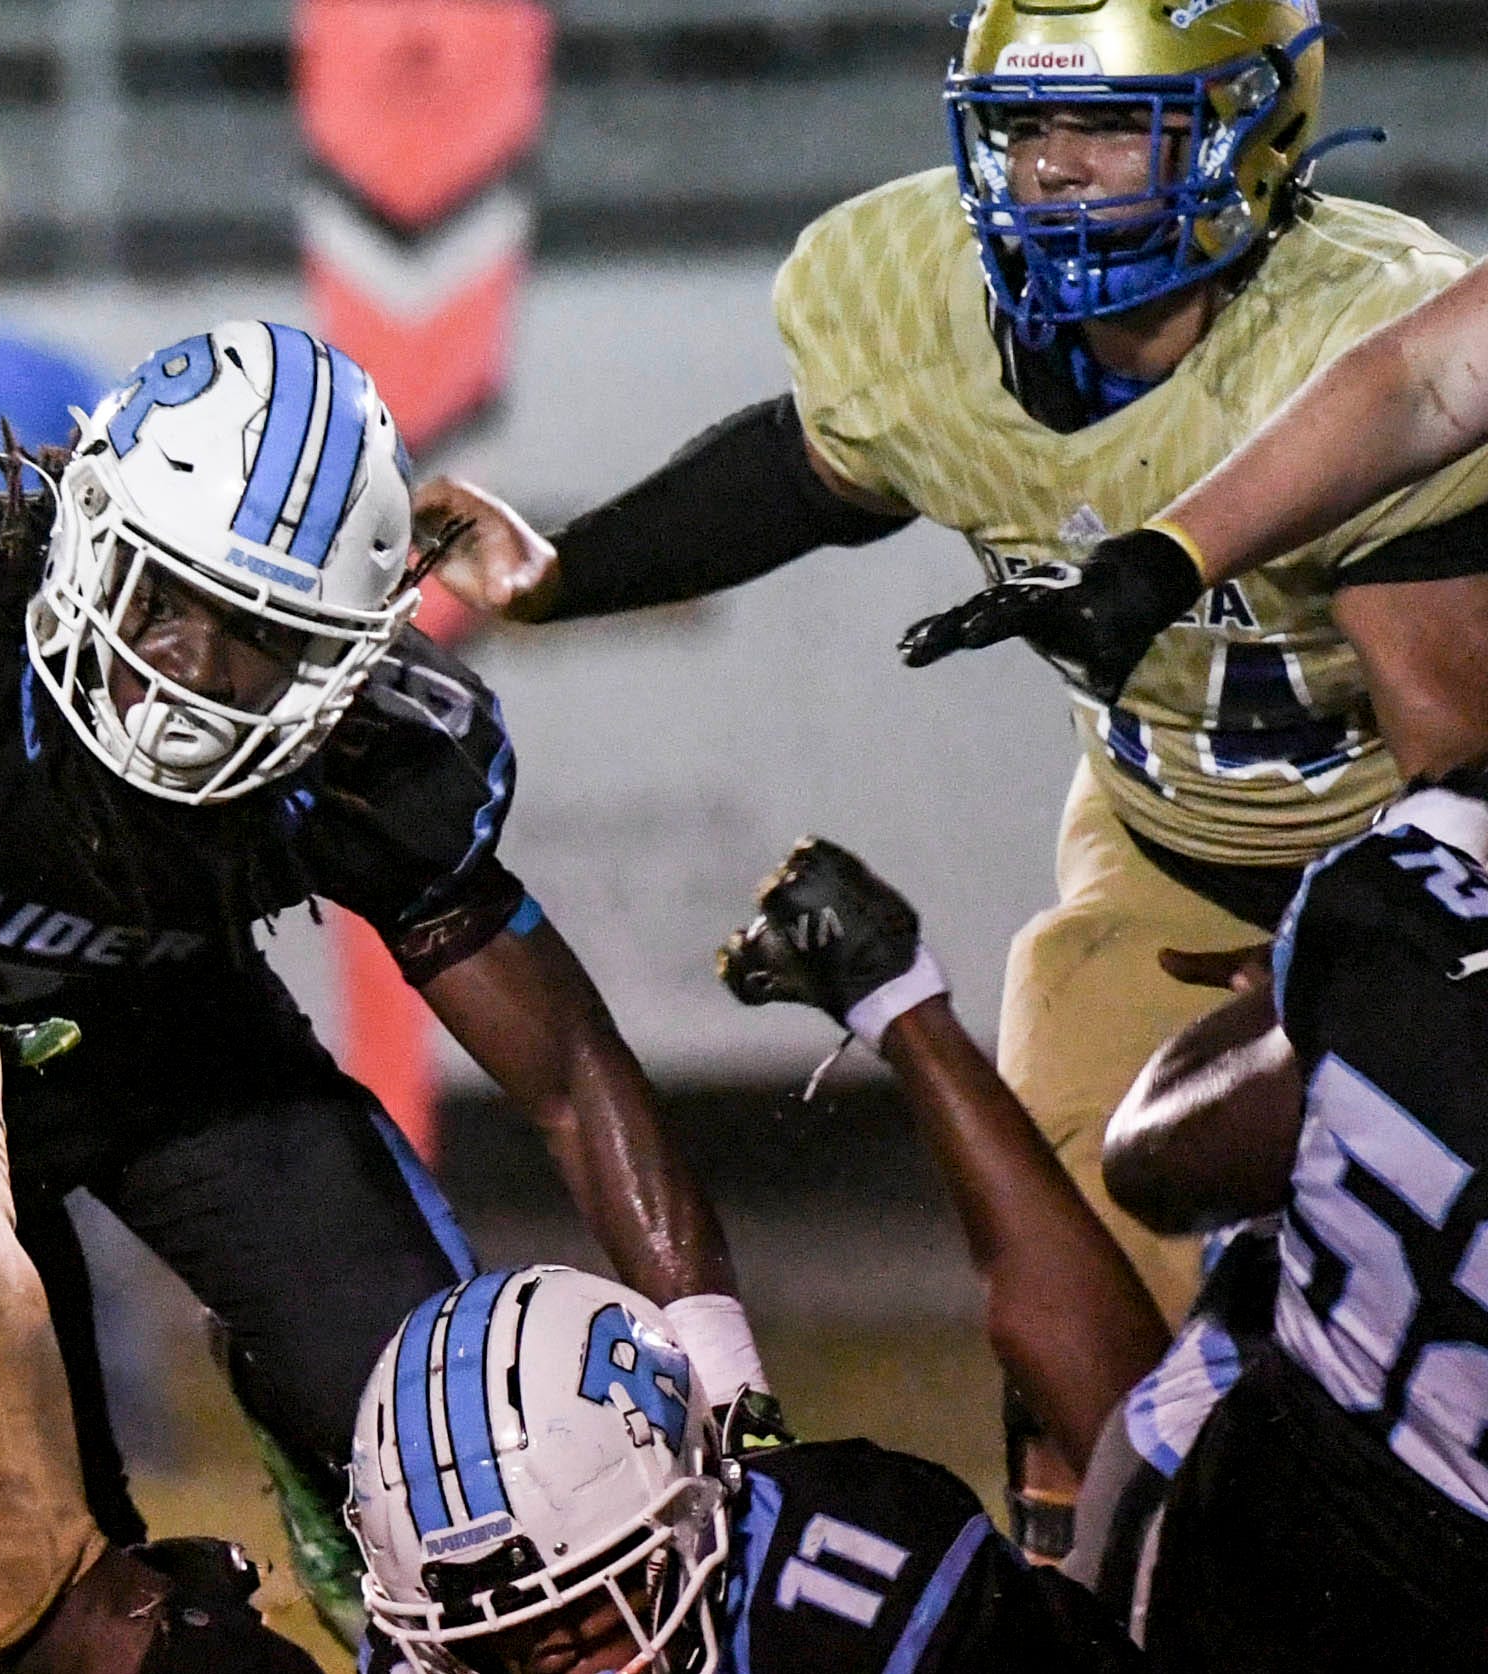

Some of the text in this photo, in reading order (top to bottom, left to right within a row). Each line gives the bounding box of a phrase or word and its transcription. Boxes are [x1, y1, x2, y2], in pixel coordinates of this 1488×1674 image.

[1006, 52, 1085, 69] Riddell
[105, 332, 220, 461] R
[577, 1302, 690, 1458] R
[774, 1512, 912, 1630] 11
